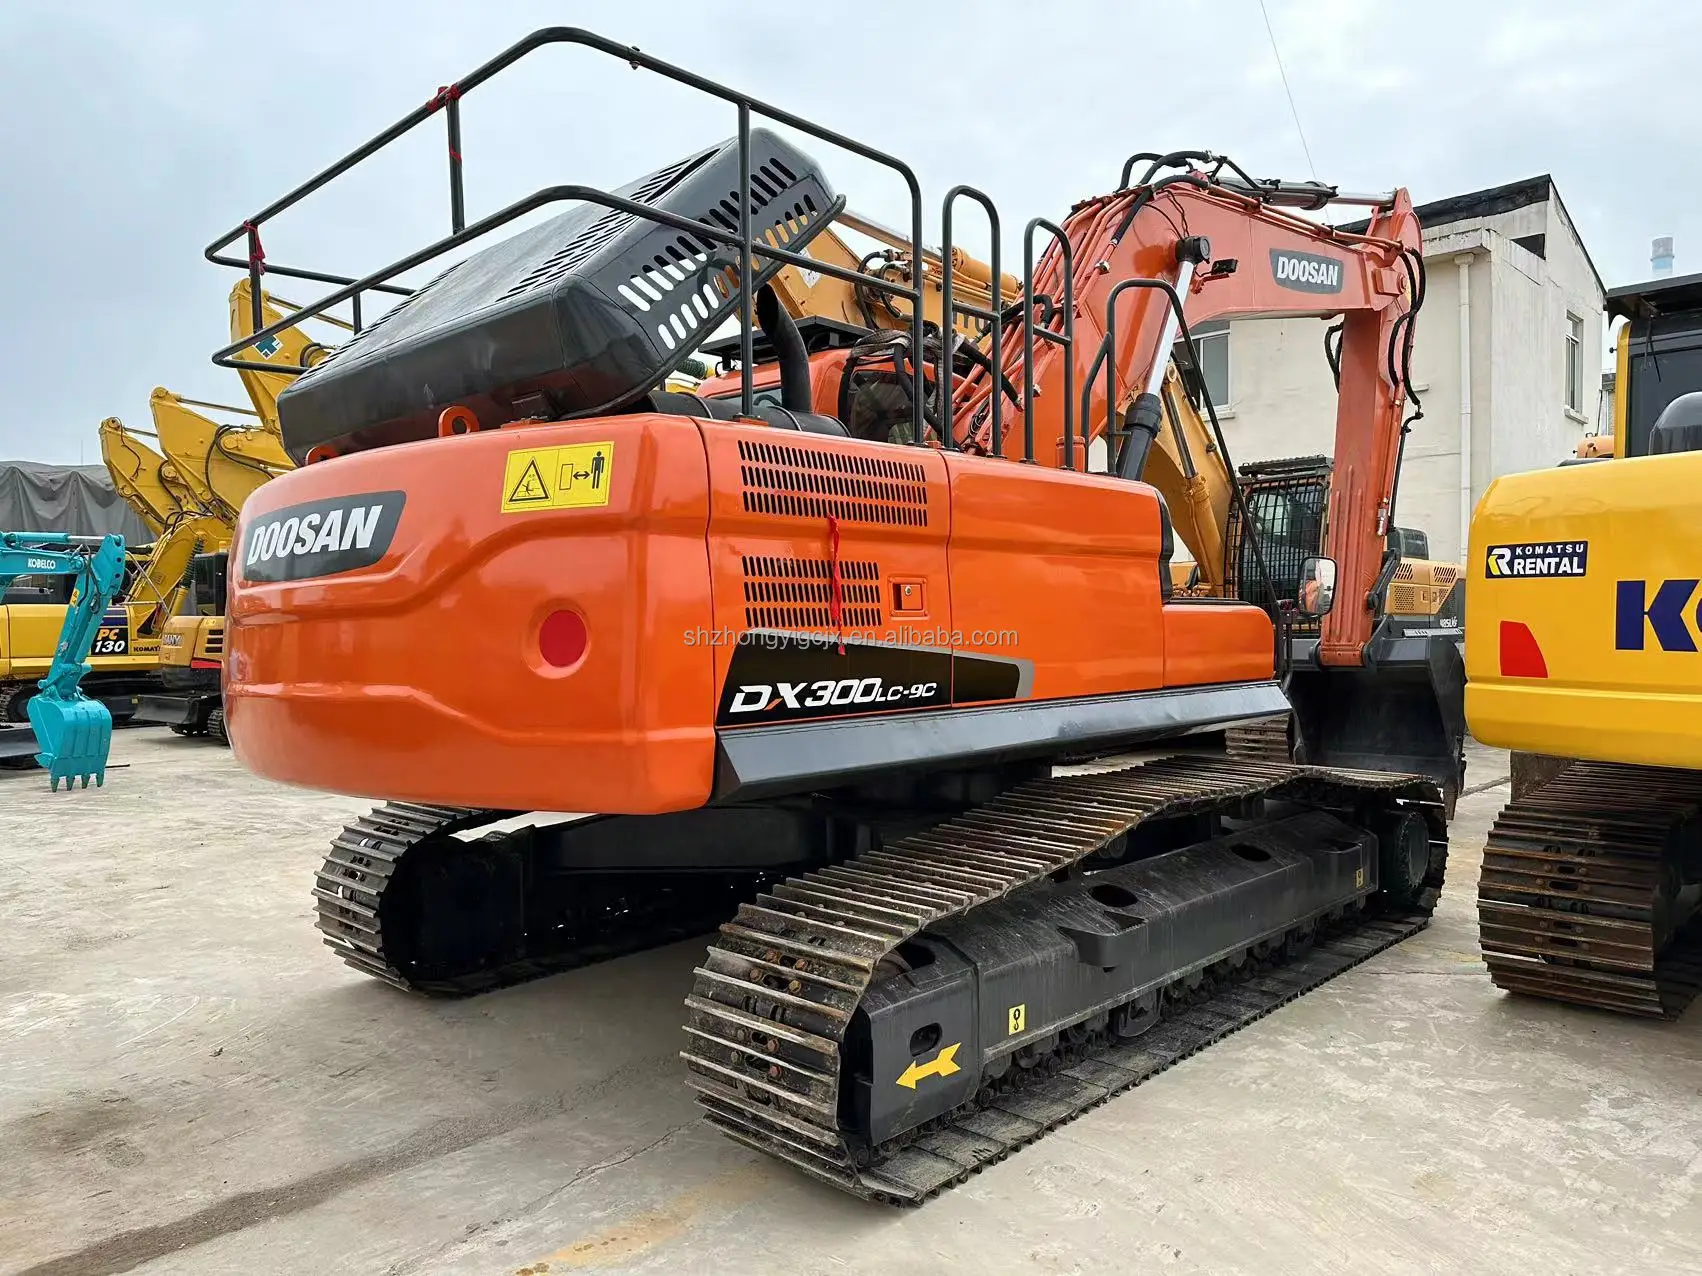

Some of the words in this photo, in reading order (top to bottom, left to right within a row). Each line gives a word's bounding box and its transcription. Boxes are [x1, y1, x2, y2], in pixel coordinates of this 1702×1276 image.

[1277, 256, 1339, 286] DOOSAN
[247, 505, 383, 566] DOOSAN
[1515, 544, 1584, 555] KOMATSU
[28, 558, 56, 570] KOBELCO
[1513, 557, 1584, 575] RENTAL
[1615, 580, 1702, 652] K
[97, 629, 119, 640] PC
[95, 640, 126, 653] 130
